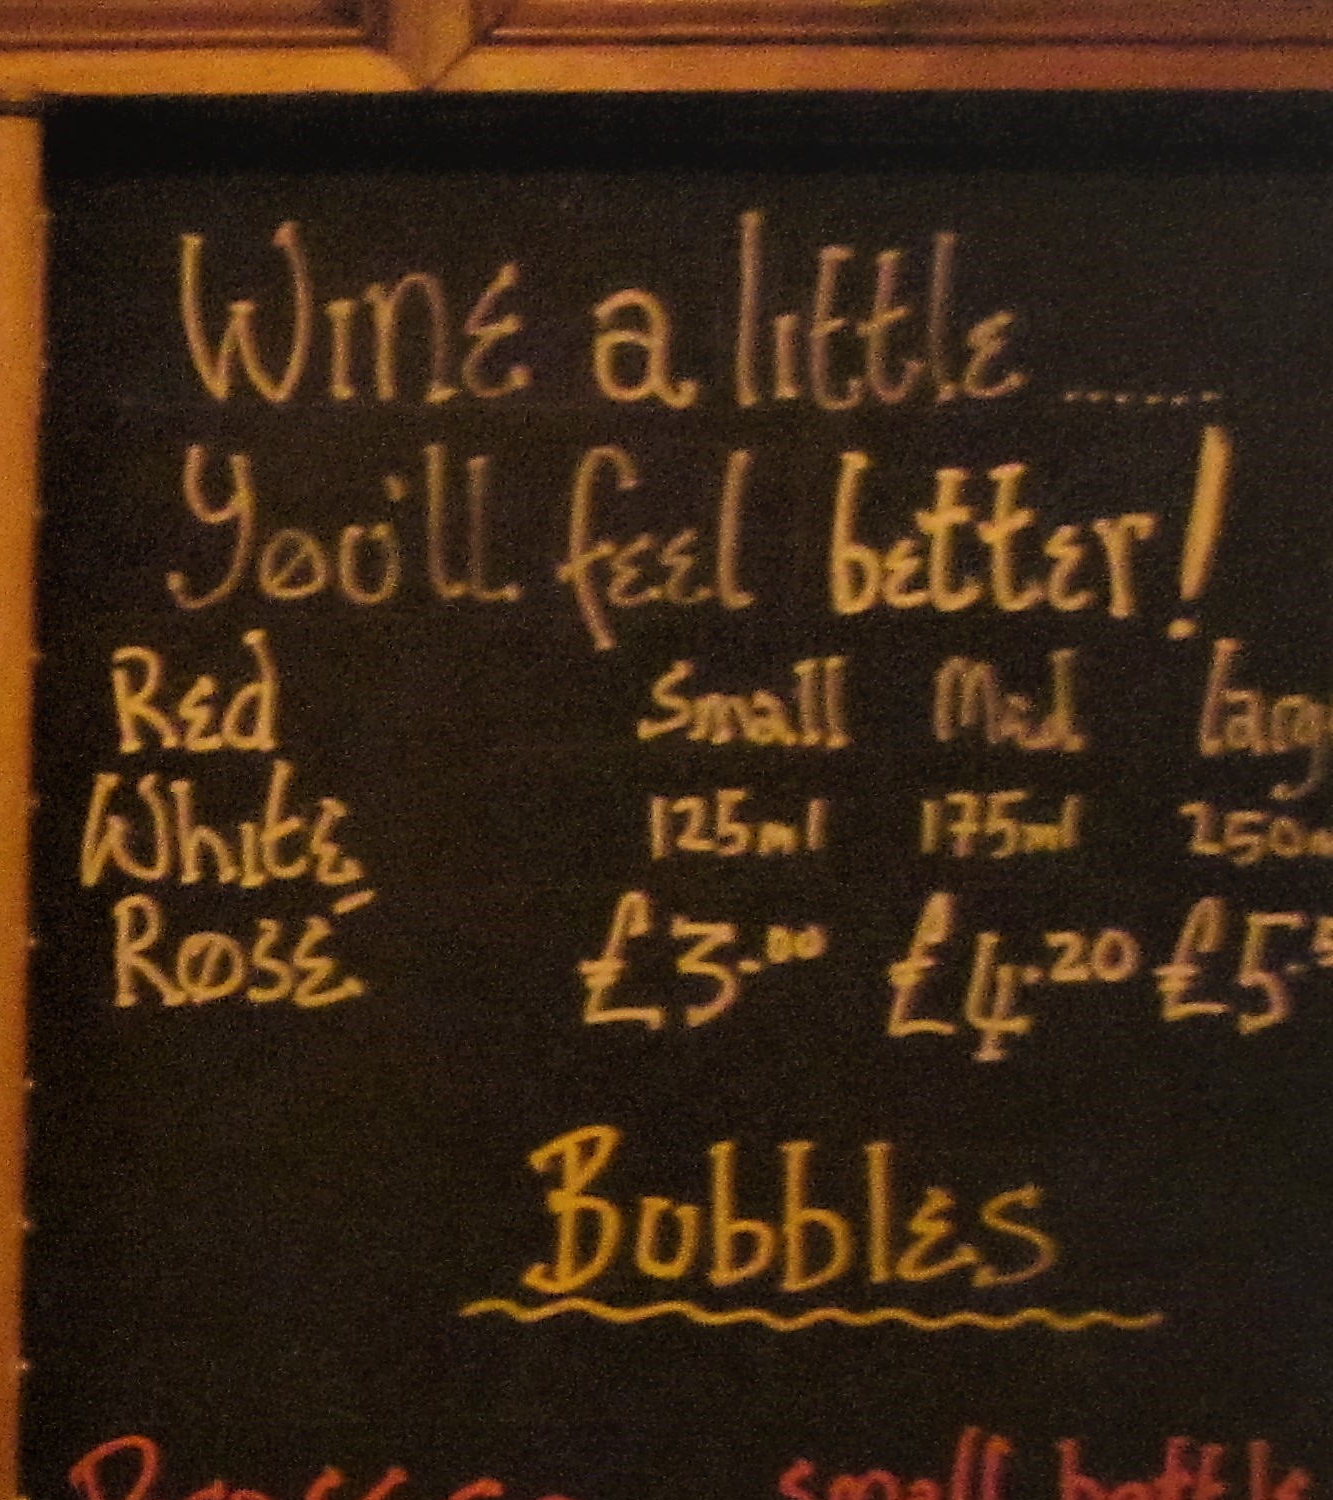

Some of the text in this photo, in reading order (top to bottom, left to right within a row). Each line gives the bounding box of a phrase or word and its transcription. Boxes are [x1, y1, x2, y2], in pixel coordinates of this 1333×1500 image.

[178, 221, 533, 404] Wine
[593, 288, 698, 408] a
[735, 209, 1027, 408] little
[165, 442, 525, 611] You'll
[558, 444, 755, 651] feel
[111, 628, 279, 753] Red
[1199, 637, 1333, 800] larg
[79, 760, 1333, 887] White 125ml 175ml 250m
[111, 889, 376, 1007] Rosé
[889, 890, 1139, 1062] £4.20
[523, 1124, 1063, 1294] Bubbles
